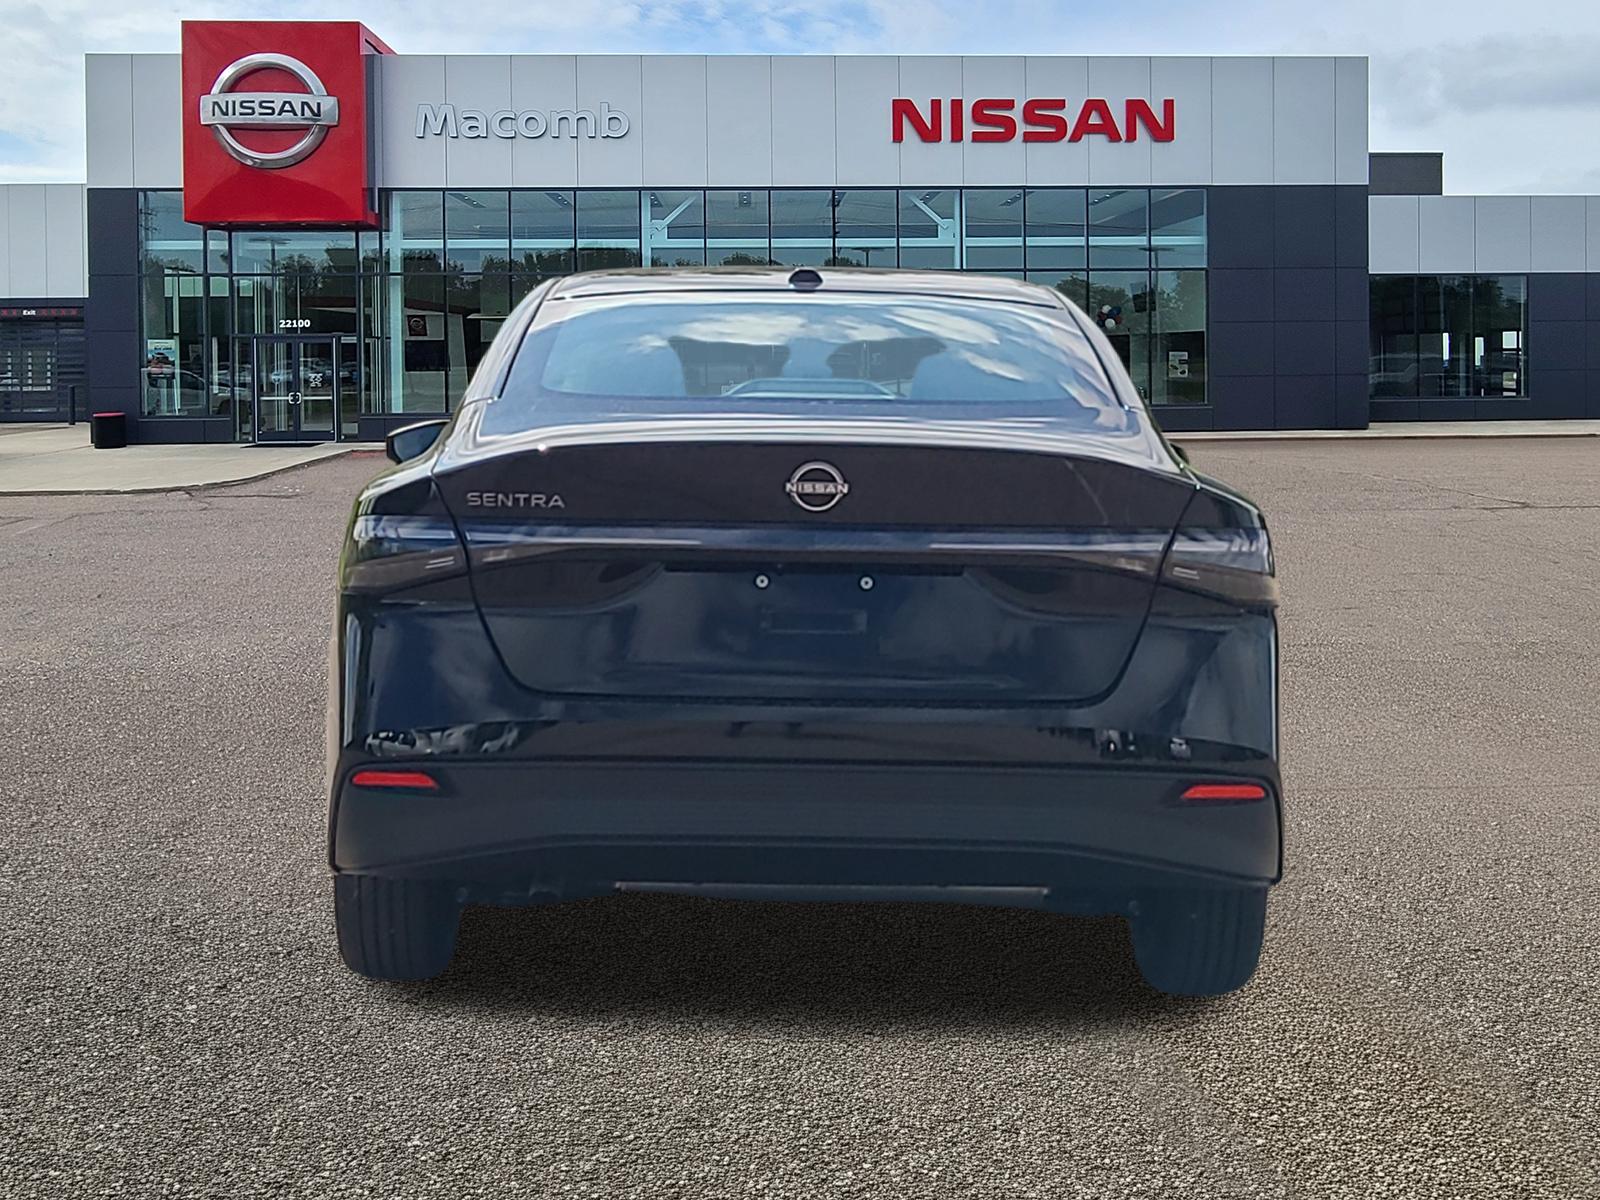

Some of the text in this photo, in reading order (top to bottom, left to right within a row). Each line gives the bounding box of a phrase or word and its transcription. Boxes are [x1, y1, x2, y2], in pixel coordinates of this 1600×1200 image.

[211, 100, 322, 118] NISSAN
[415, 102, 630, 139] Macomb
[892, 98, 1175, 143] NISSAN
[279, 319, 311, 328] 22100
[785, 481, 849, 494] NISSAN
[466, 492, 566, 508] SENTRA
